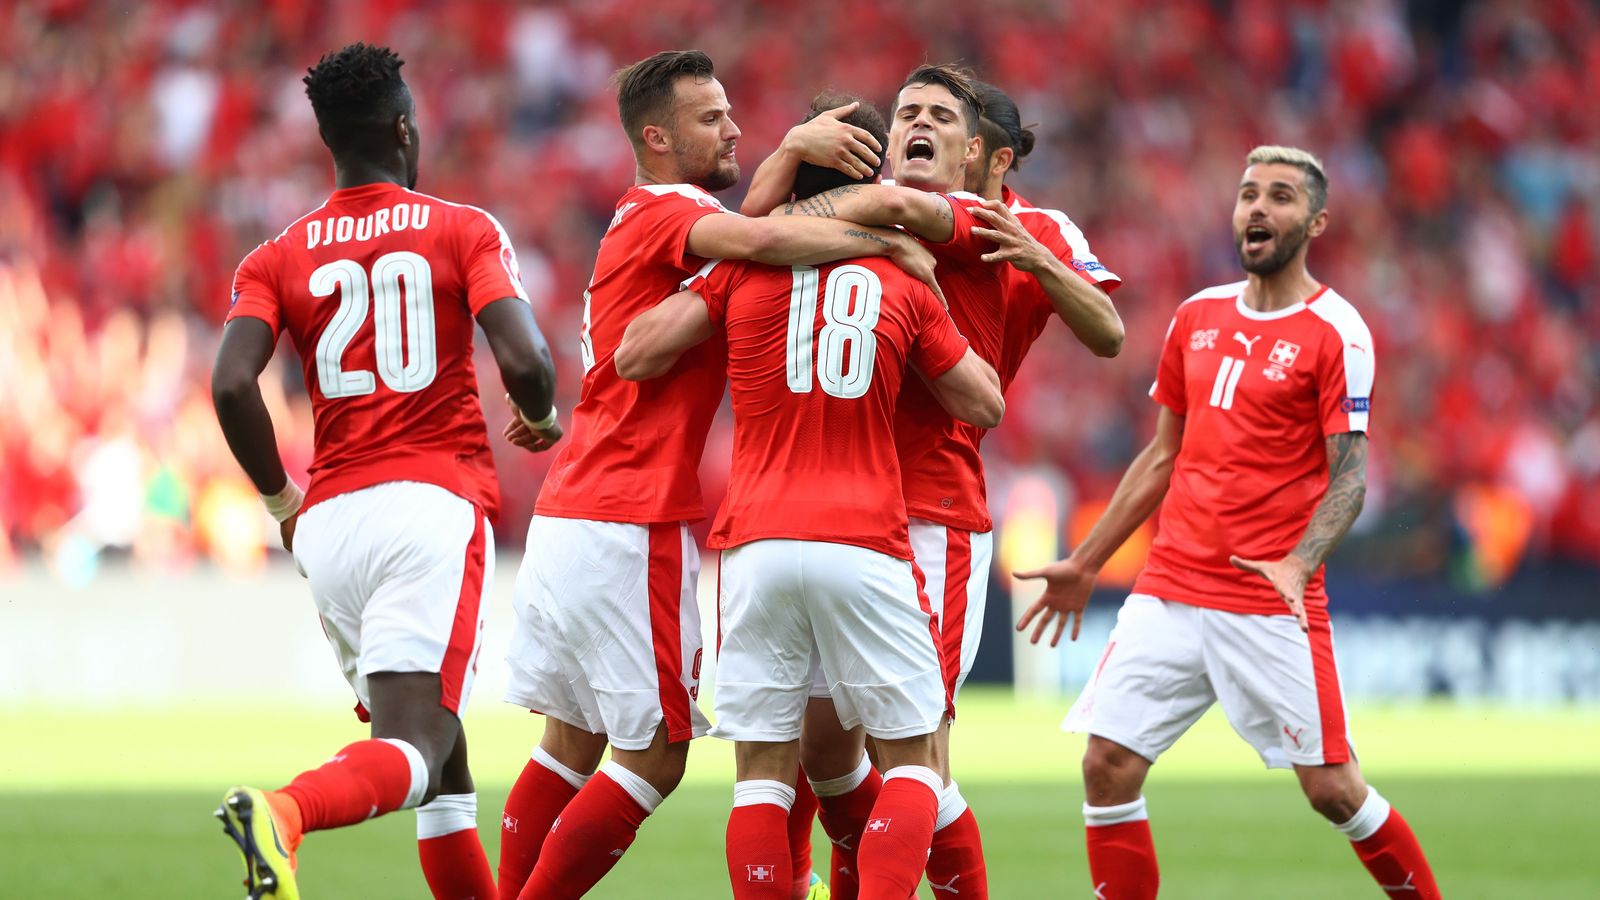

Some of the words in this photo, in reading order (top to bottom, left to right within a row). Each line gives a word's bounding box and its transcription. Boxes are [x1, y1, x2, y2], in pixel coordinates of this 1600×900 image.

[306, 203, 430, 250] DJOUROU
[308, 251, 438, 399] 20
[786, 264, 883, 399] 18
[1209, 355, 1246, 411] 11
